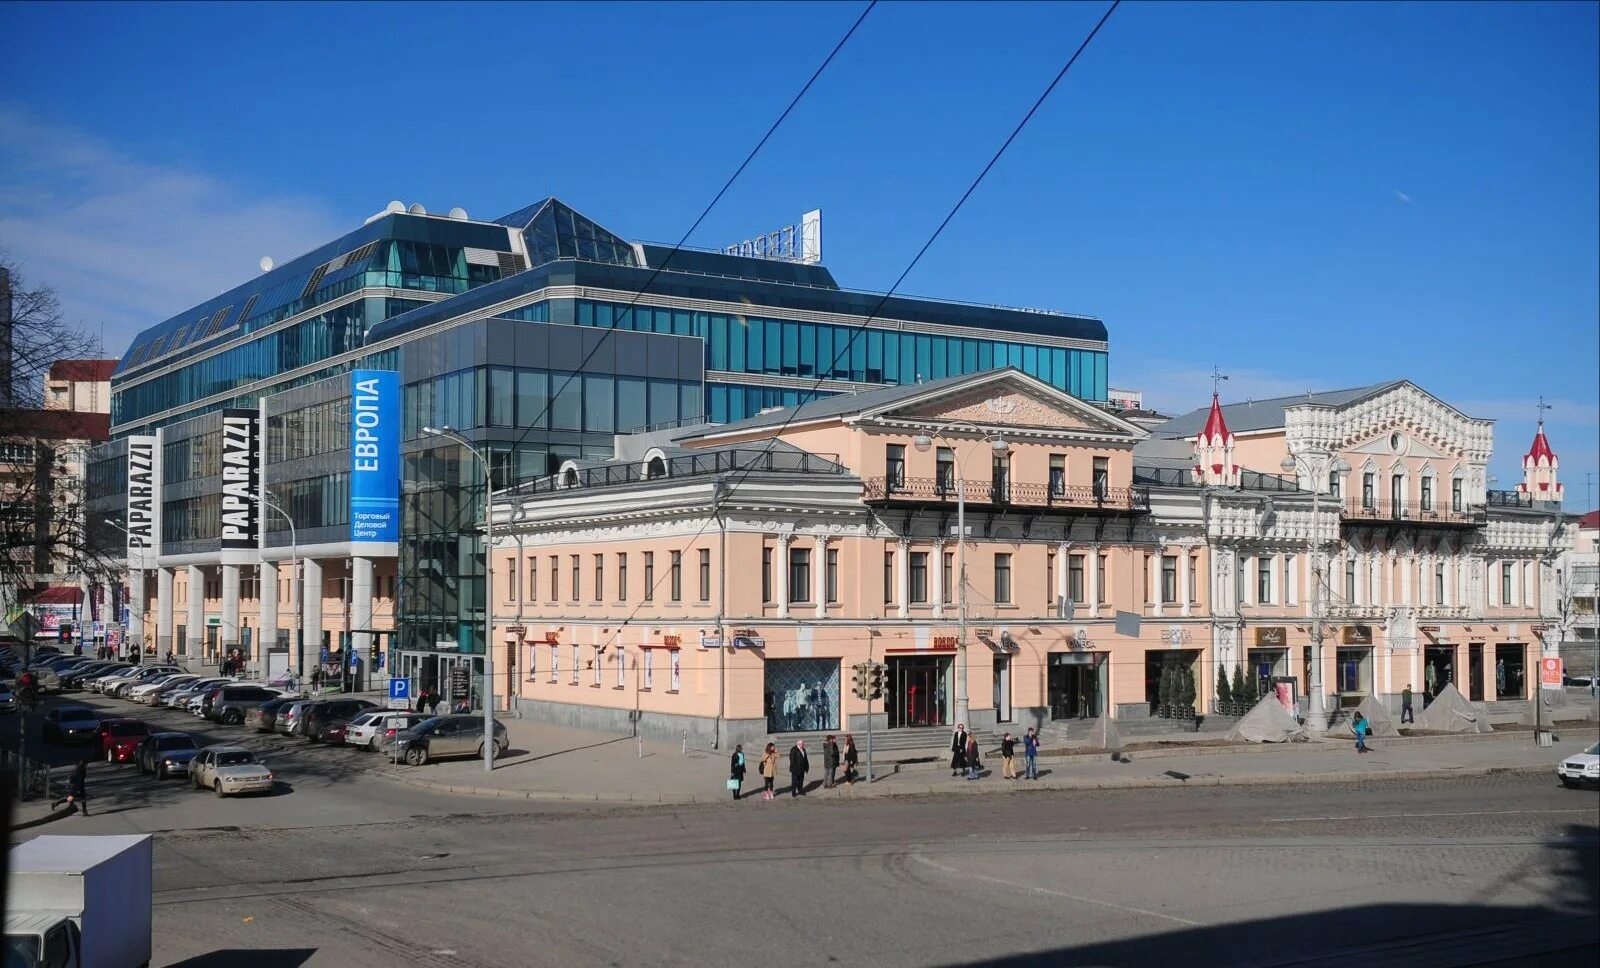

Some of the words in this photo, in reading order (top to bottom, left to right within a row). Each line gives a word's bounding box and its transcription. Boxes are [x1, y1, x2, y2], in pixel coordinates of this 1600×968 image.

[355, 378, 379, 471] ЕВРОПА
[222, 417, 250, 540] PAPARAZZI
[129, 443, 153, 548] PAPARAZZI
[354, 512, 390, 520] Торговый
[354, 521, 387, 529] Деловой
[353, 530, 377, 538] Центр
[394, 680, 406, 696] P
